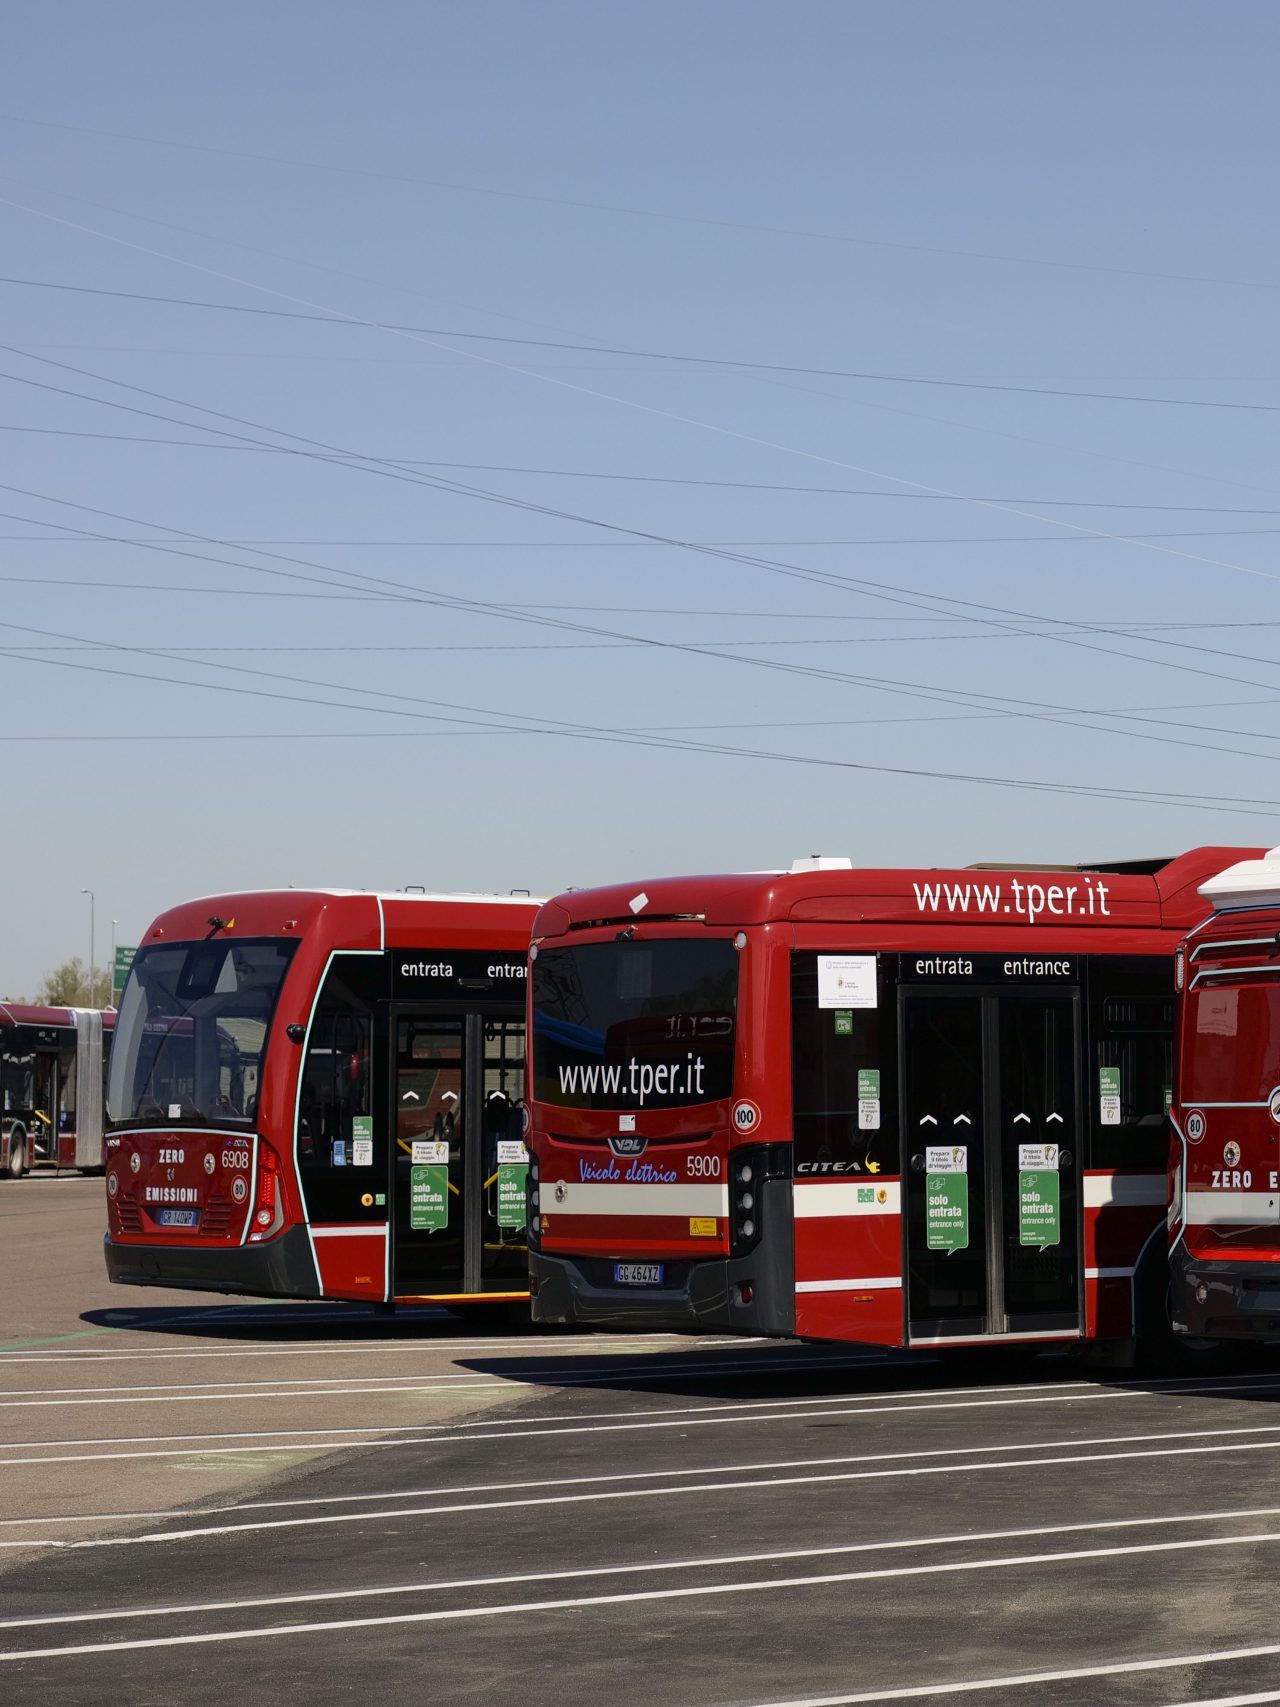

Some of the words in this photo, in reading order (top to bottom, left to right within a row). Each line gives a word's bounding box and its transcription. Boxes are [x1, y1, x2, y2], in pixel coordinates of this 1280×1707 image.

[913, 877, 1111, 924] www.tper.it
[401, 961, 453, 977] entrata
[916, 956, 973, 975] entrata
[1003, 958, 1070, 976] entrance
[559, 1052, 705, 1106] www.tper.it
[737, 1109, 754, 1124] 100
[1190, 1119, 1201, 1133] 80
[614, 1139, 641, 1151] VDL
[158, 1149, 185, 1164] ZERO
[222, 1150, 249, 1169] 6908
[579, 1158, 621, 1182] Veicolo
[625, 1159, 678, 1183] elettrico
[686, 1155, 721, 1177] 5900
[797, 1161, 862, 1173] CITEA
[499, 1181, 518, 1191] solo
[1211, 1170, 1252, 1189] ZERO
[145, 1187, 198, 1203] EMISSIONI
[412, 1183, 431, 1193] solo
[412, 1193, 443, 1203] entrata
[929, 1194, 948, 1206] solo
[1021, 1191, 1041, 1203] solo
[929, 1206, 962, 1217] entrata
[1021, 1203, 1054, 1214] entrata
[953, 1220, 965, 1229] only
[1022, 1217, 1044, 1225] entrance
[1045, 1217, 1056, 1225] only
[631, 1265, 659, 1282] 464XZ
